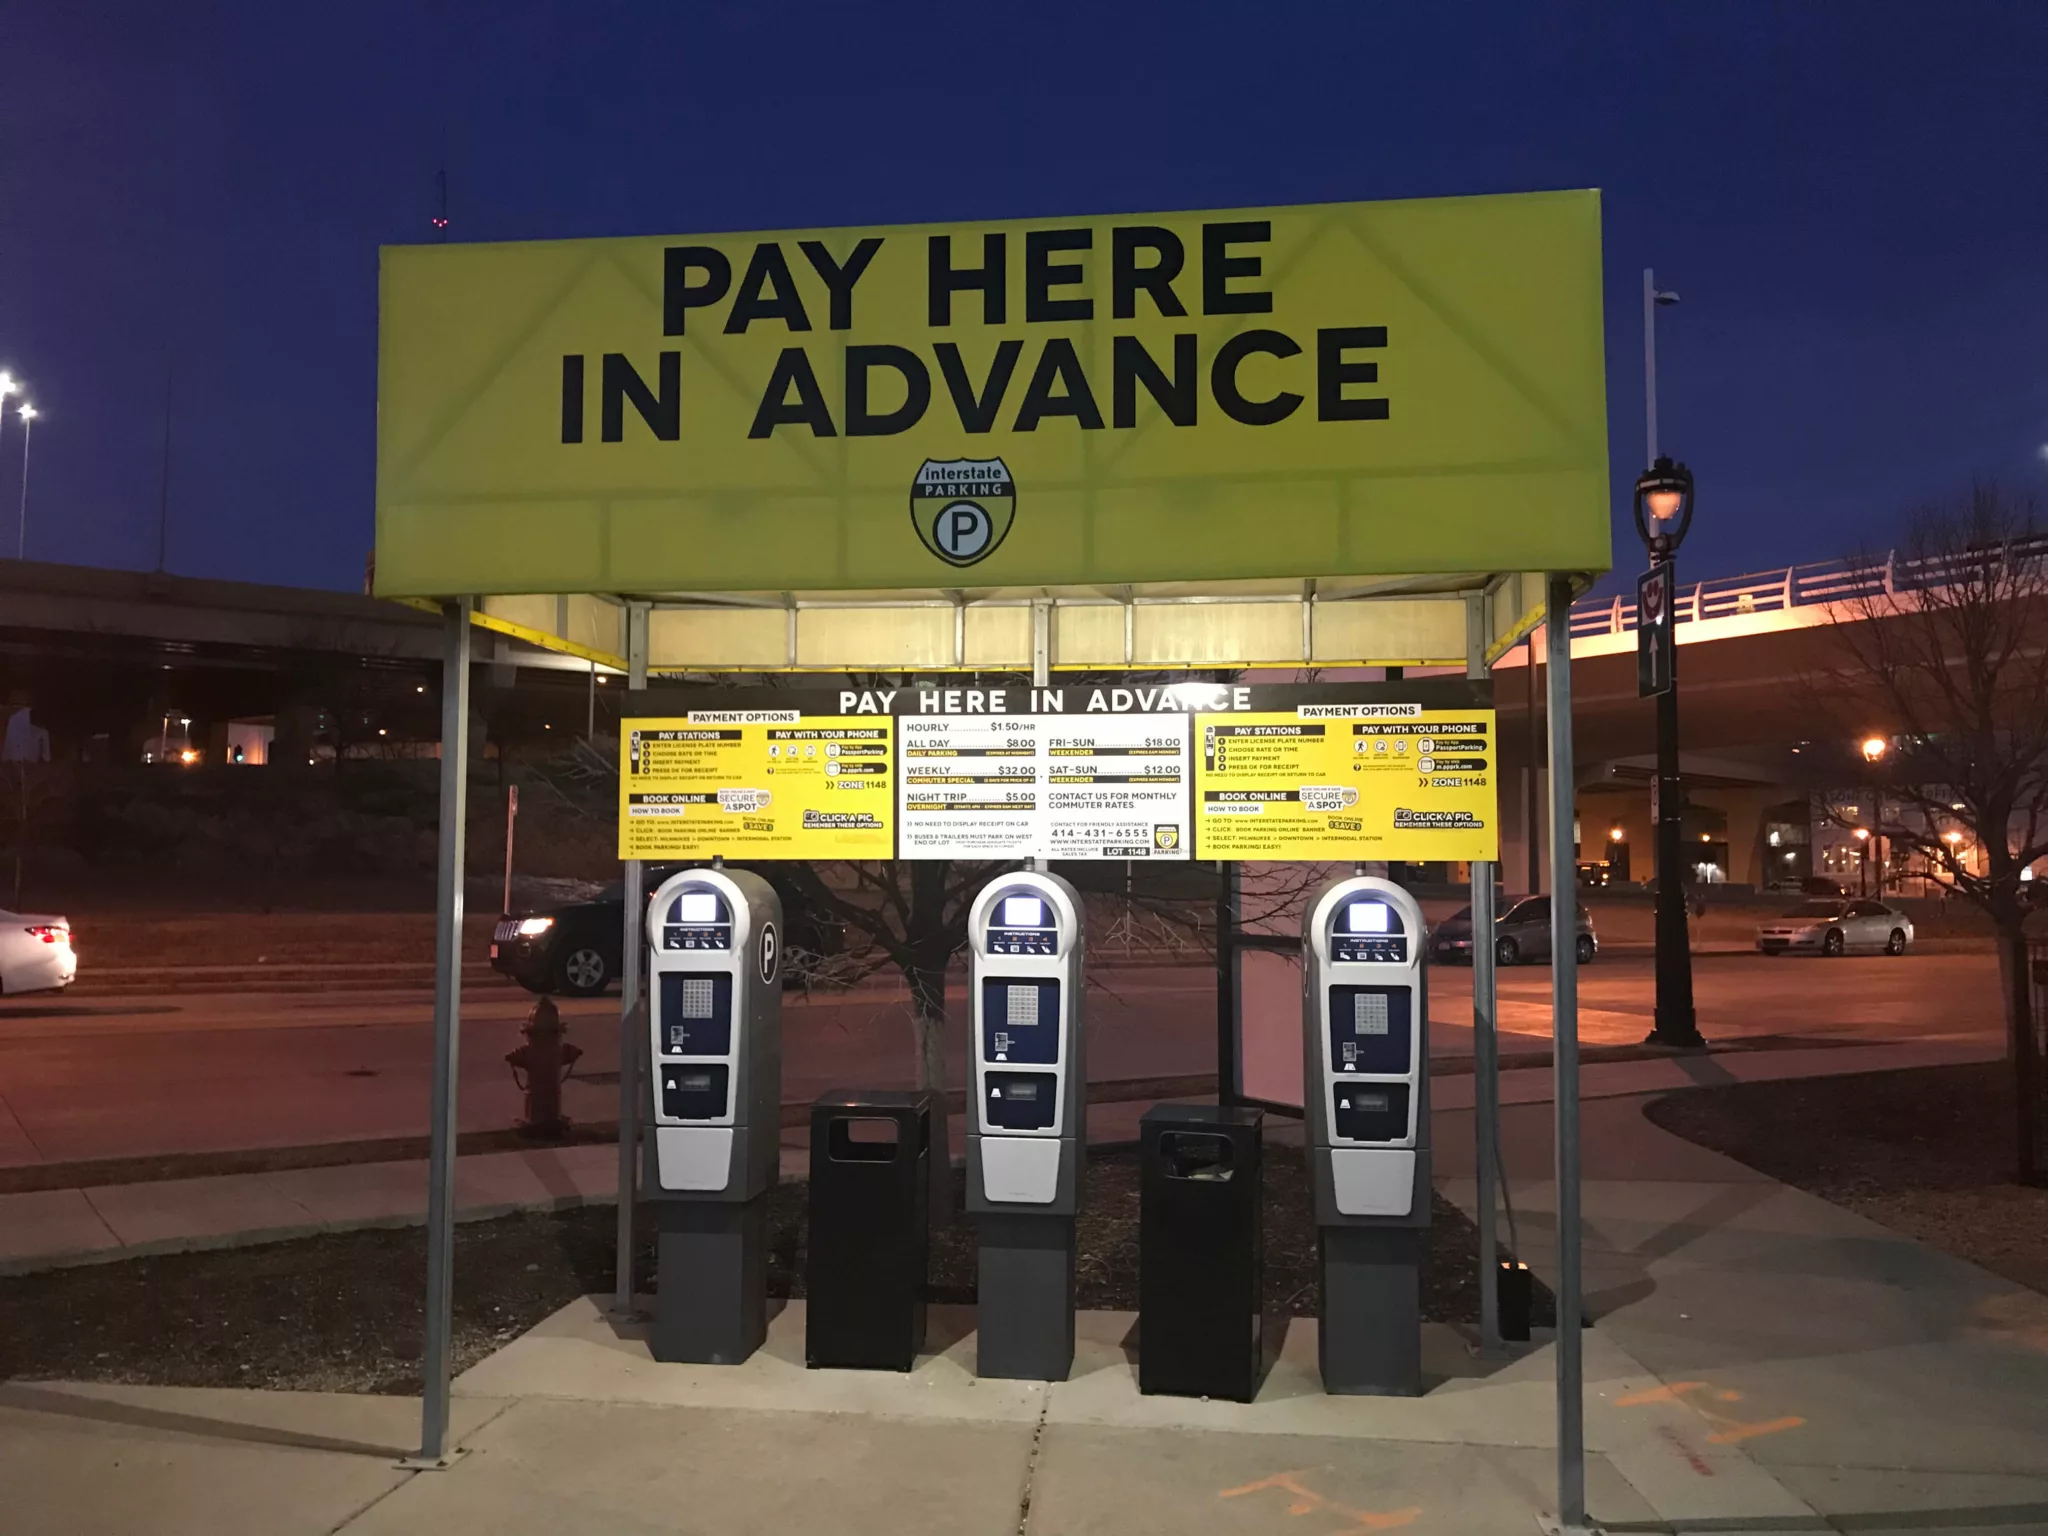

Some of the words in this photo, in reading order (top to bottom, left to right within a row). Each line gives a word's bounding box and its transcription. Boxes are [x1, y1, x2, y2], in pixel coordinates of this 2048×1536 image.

[663, 238, 885, 336] PAY
[928, 220, 1274, 327] HERE
[561, 351, 682, 444] IN
[747, 326, 1390, 439] ADVANCE
[925, 467, 1001, 480] interstate
[925, 484, 1001, 496] PARKING
[952, 512, 978, 551] P
[840, 691, 897, 714] PAY
[920, 690, 1006, 713] HERE
[1031, 690, 1063, 713] IN
[1304, 707, 1358, 716] PAYMENT
[1362, 707, 1415, 715] OPTIONS
[693, 714, 743, 722] PAYMENT
[746, 713, 794, 722] OPTIONS
[991, 722, 1035, 731] $1.50/HR
[1362, 726, 1380, 734] PAY
[1412, 725, 1439, 733] YOUR
[1007, 739, 1035, 748] $8.00
[1145, 738, 1180, 748] $18.00
[998, 766, 1035, 775] $32.00
[1049, 766, 1097, 774] SAT-SUN
[1144, 765, 1180, 774] $12.00
[907, 793, 940, 801] NIGHT
[944, 793, 966, 801] TRIP
[1006, 792, 1035, 801] $5.00
[1302, 792, 1340, 800] SECURE
[1052, 829, 1148, 837] 414-431-6555
[764, 932, 774, 973] P
